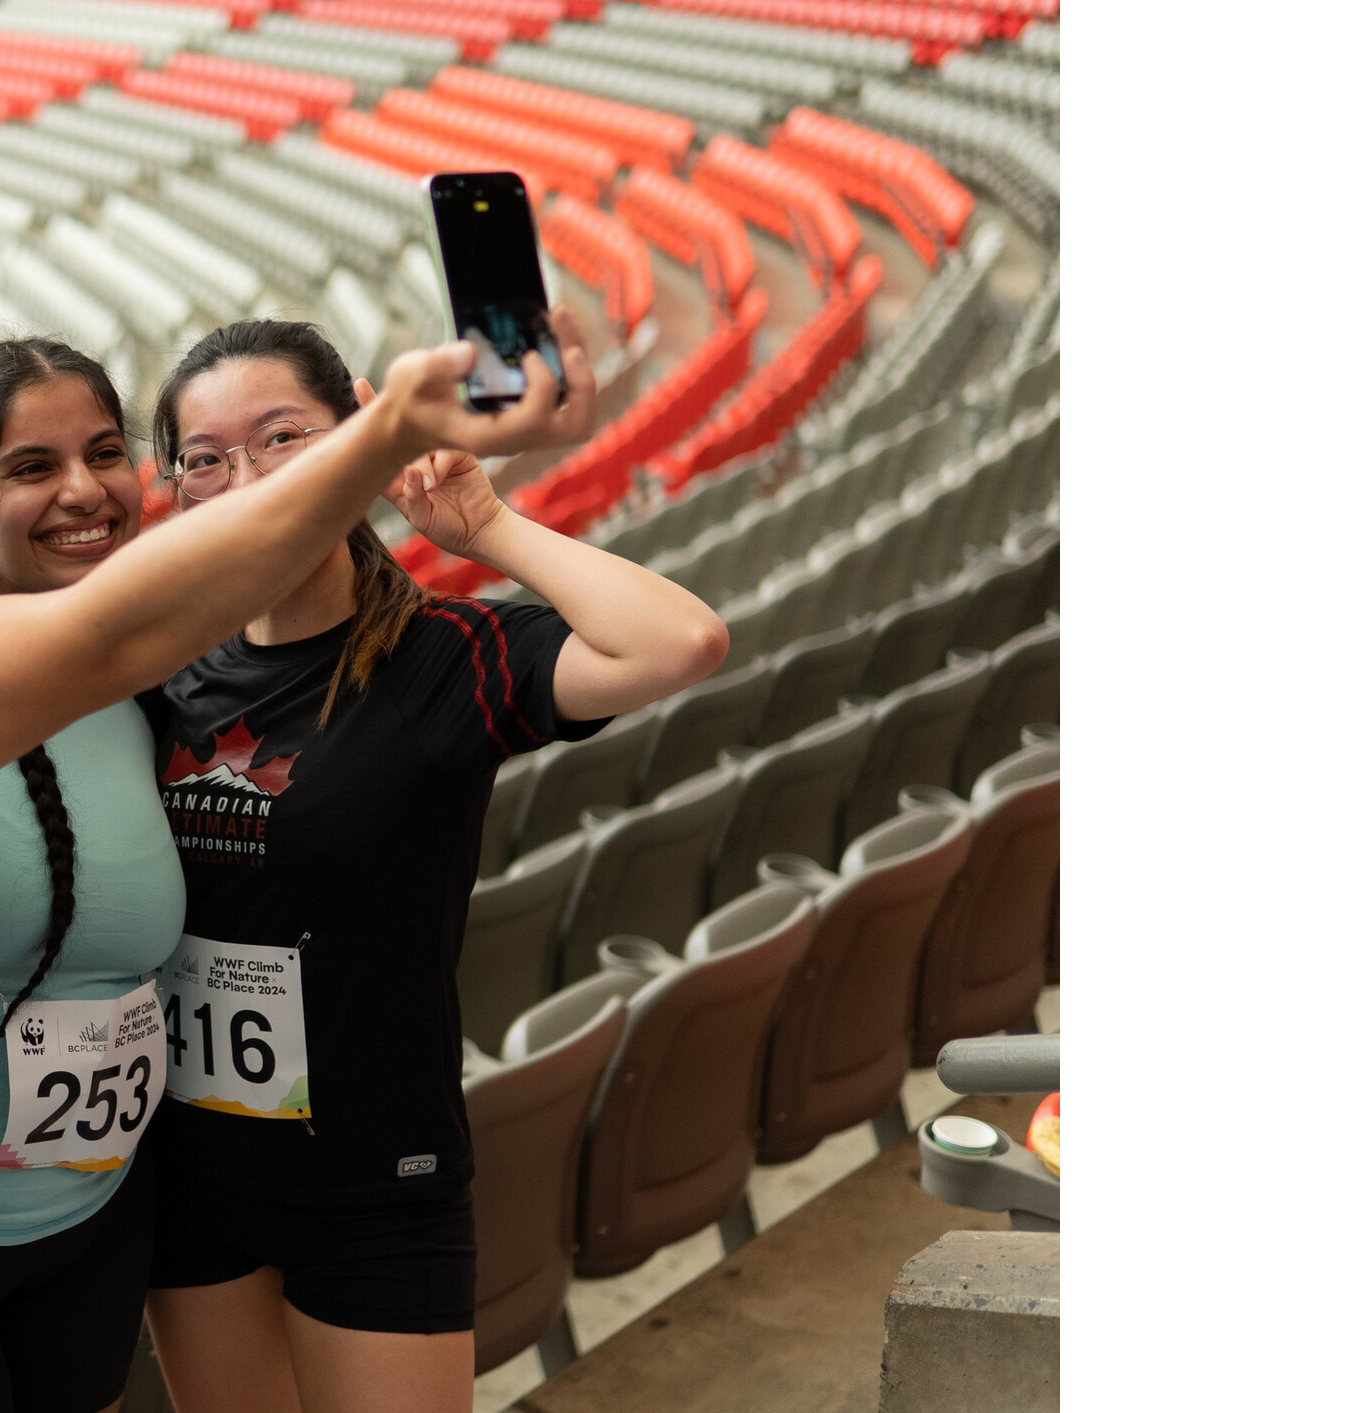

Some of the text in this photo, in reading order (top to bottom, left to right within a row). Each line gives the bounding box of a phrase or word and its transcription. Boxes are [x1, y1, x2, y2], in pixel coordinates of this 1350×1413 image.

[162, 791, 272, 817] CANADIAN
[170, 811, 267, 839] LTIMATE
[175, 836, 266, 855] AMPIONSHIPS
[210, 966, 225, 979] For
[229, 970, 269, 984] Nature
[213, 956, 284, 973] WWF Climb
[207, 977, 286, 996] BC Place 2024
[123, 999, 157, 1023] WWF Climb
[115, 1023, 160, 1048] BC Place 2024
[118, 1015, 153, 1036] For Nature
[164, 993, 276, 1084] 416
[23, 1047, 45, 1056] WWF
[24, 1055, 151, 1145] 253
